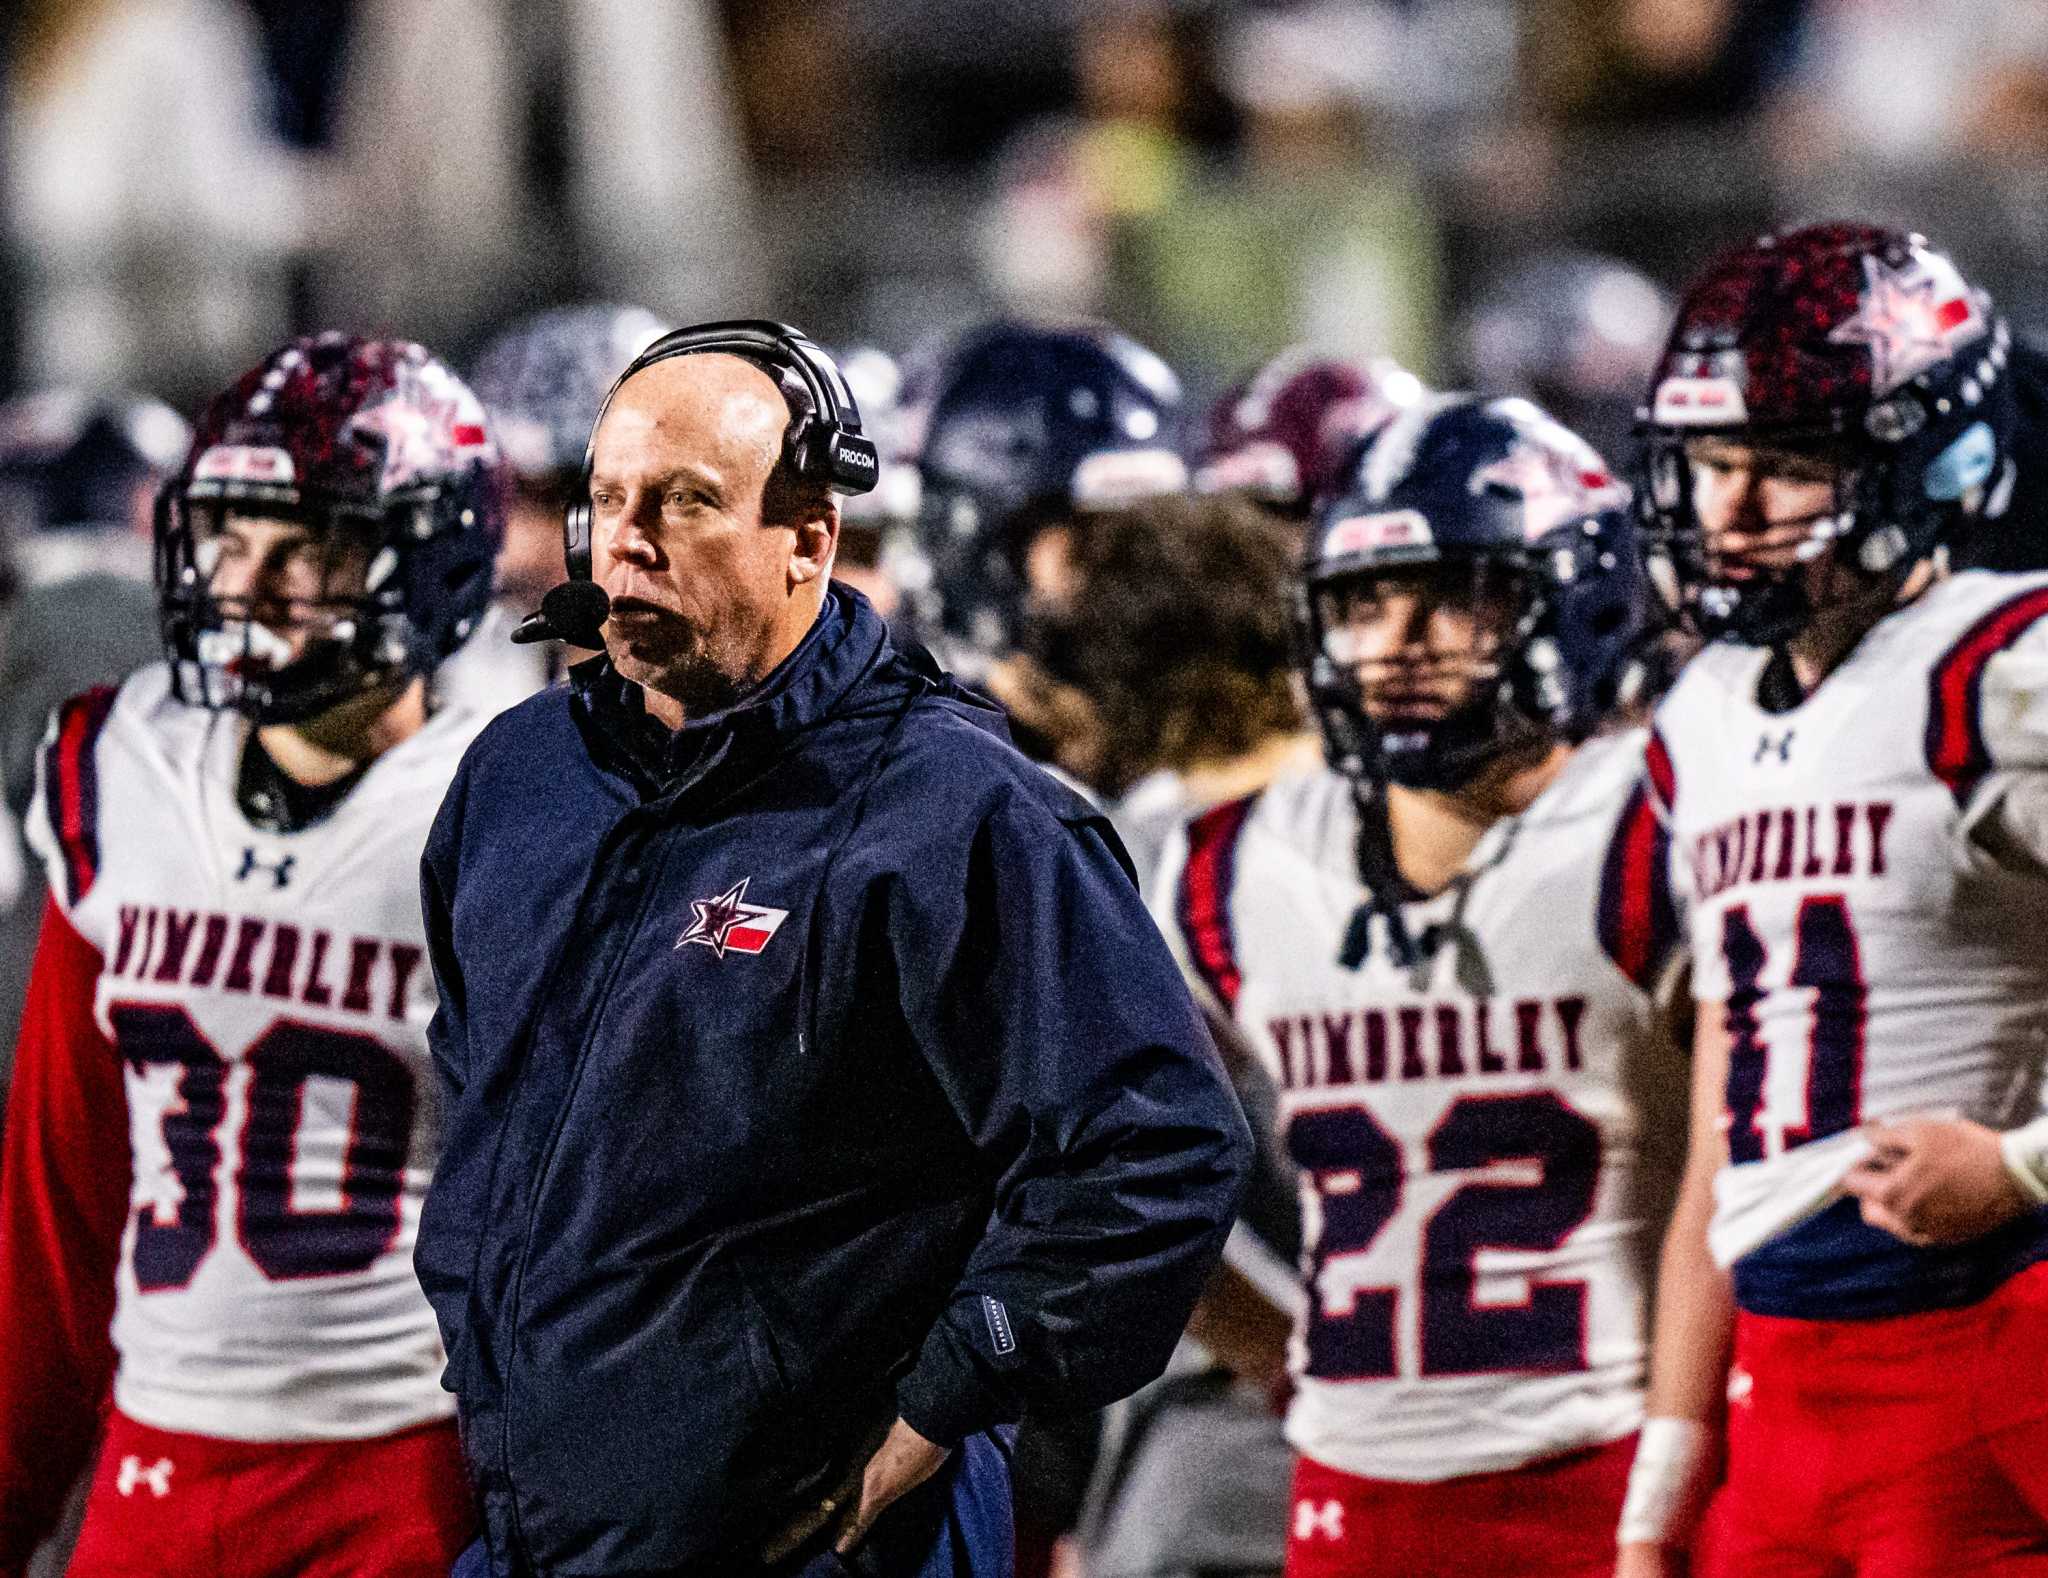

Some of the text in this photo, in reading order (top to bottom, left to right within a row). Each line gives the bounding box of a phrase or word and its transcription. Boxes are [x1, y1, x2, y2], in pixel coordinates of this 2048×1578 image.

[839, 447, 875, 470] PROCOM
[109, 1000, 415, 1293] 30
[1722, 896, 1868, 1167] 11
[1284, 1090, 1603, 1384] 22
